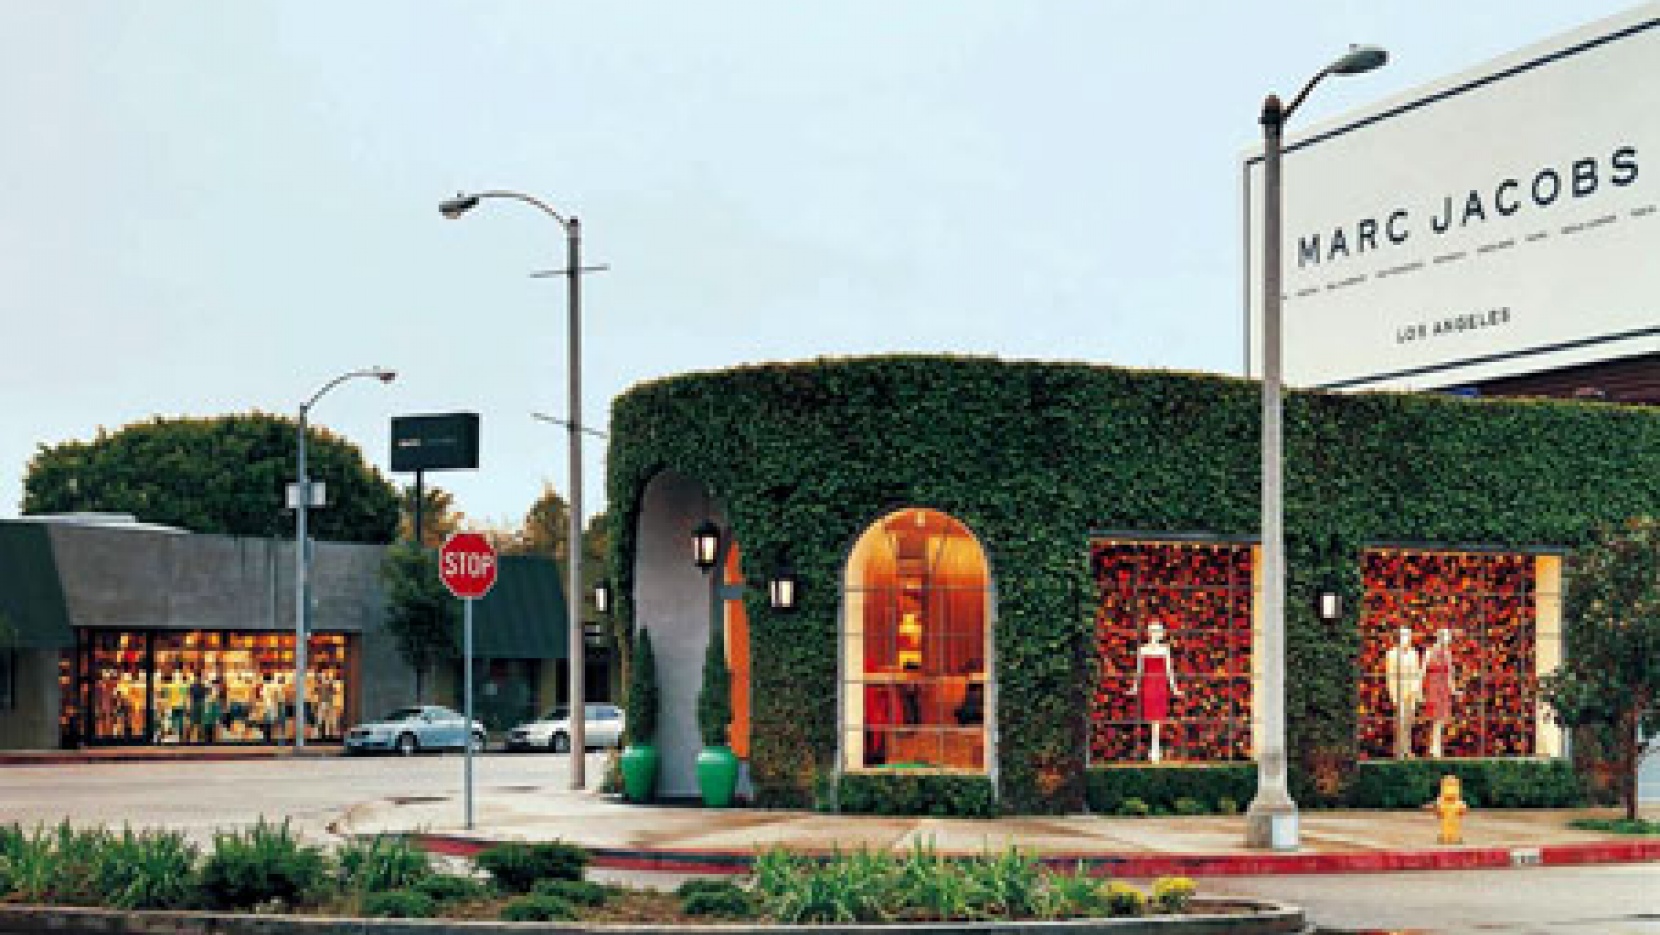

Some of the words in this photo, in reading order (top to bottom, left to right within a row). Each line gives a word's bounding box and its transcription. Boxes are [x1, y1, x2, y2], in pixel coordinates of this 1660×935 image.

[1297, 208, 1409, 268] MARC
[1430, 145, 1639, 234] JACOBS
[1396, 324, 1427, 344] LOS
[1432, 306, 1511, 336] ANGELES
[444, 551, 494, 577] STOP
